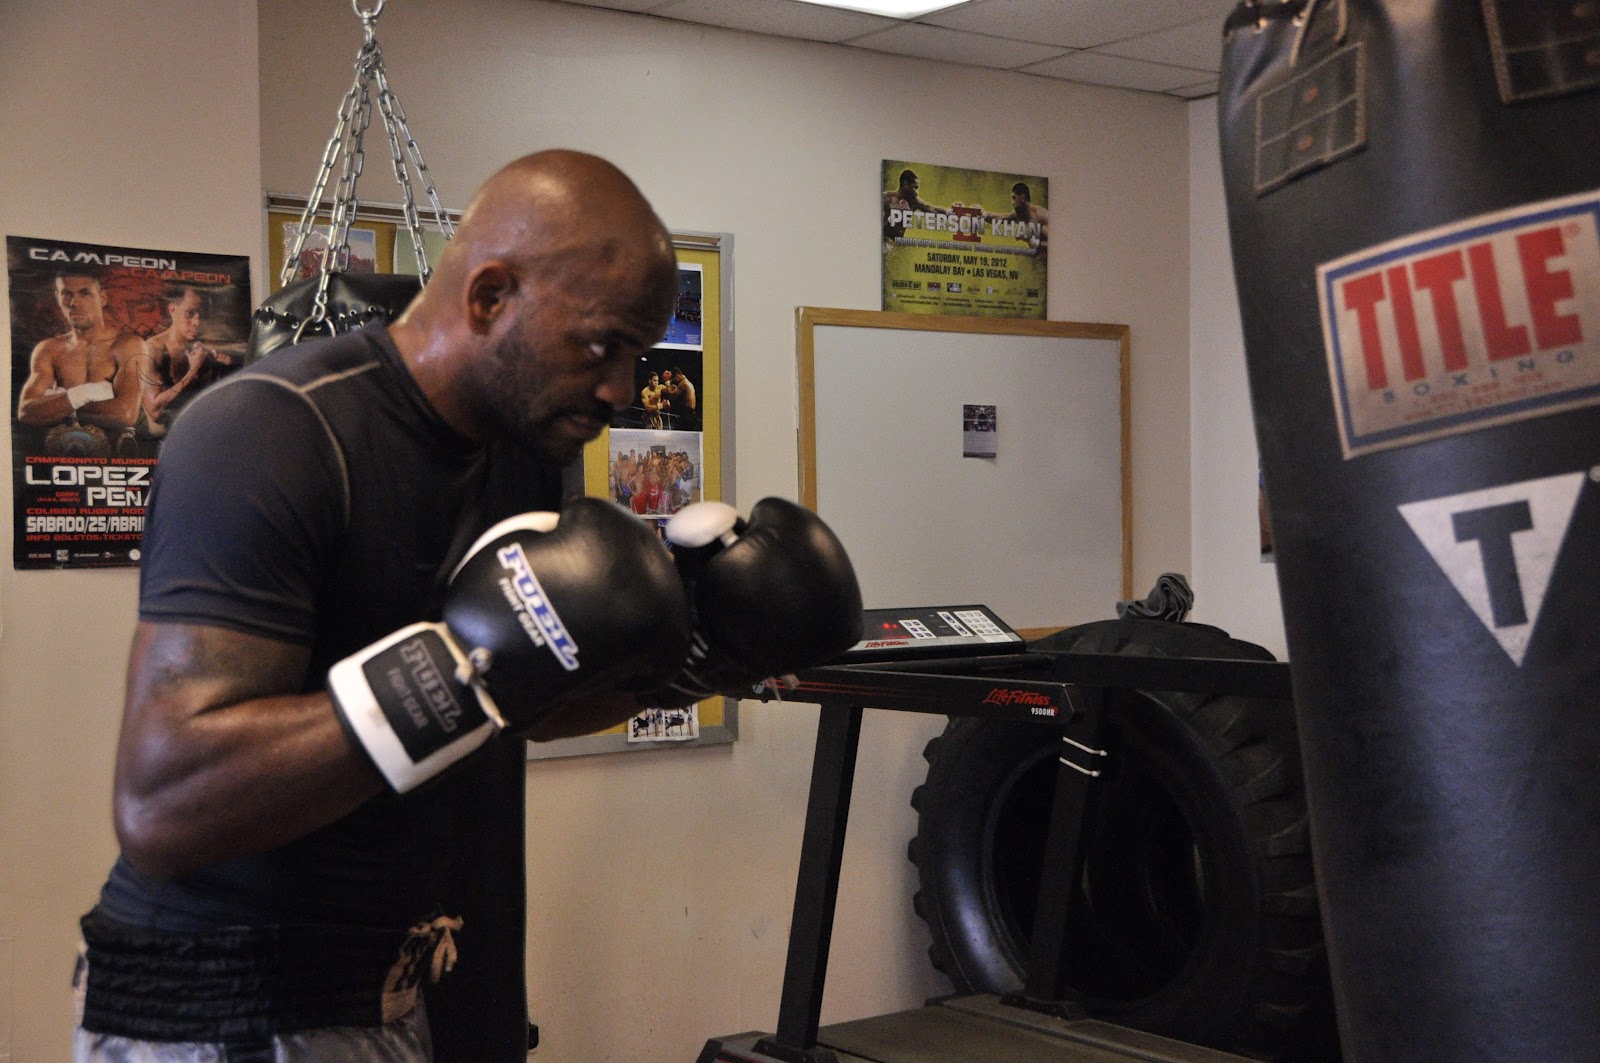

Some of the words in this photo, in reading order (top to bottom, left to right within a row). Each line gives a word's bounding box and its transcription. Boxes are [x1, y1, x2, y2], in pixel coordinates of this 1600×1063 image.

[890, 209, 985, 235] PETERSON
[992, 219, 1041, 239] KHAN
[30, 248, 176, 270] CAMPEON
[927, 252, 962, 265] SATURDAY,
[963, 255, 978, 265] MAY
[991, 257, 1007, 268] 2012
[131, 268, 232, 284] CAMPEON
[914, 264, 951, 274] MANDALAY
[953, 266, 966, 276] BAY
[972, 267, 985, 277] LAS
[1009, 271, 1019, 280] NV
[1343, 226, 1584, 390] TITLE
[25, 456, 107, 464] CAMPEONATO
[111, 457, 159, 465] MUNDIA
[25, 465, 150, 486] LOPEZ
[26, 534, 50, 542] INFO
[1451, 500, 1534, 629] T
[497, 542, 580, 672] FUEL
[1030, 707, 1056, 717] 9500HR
